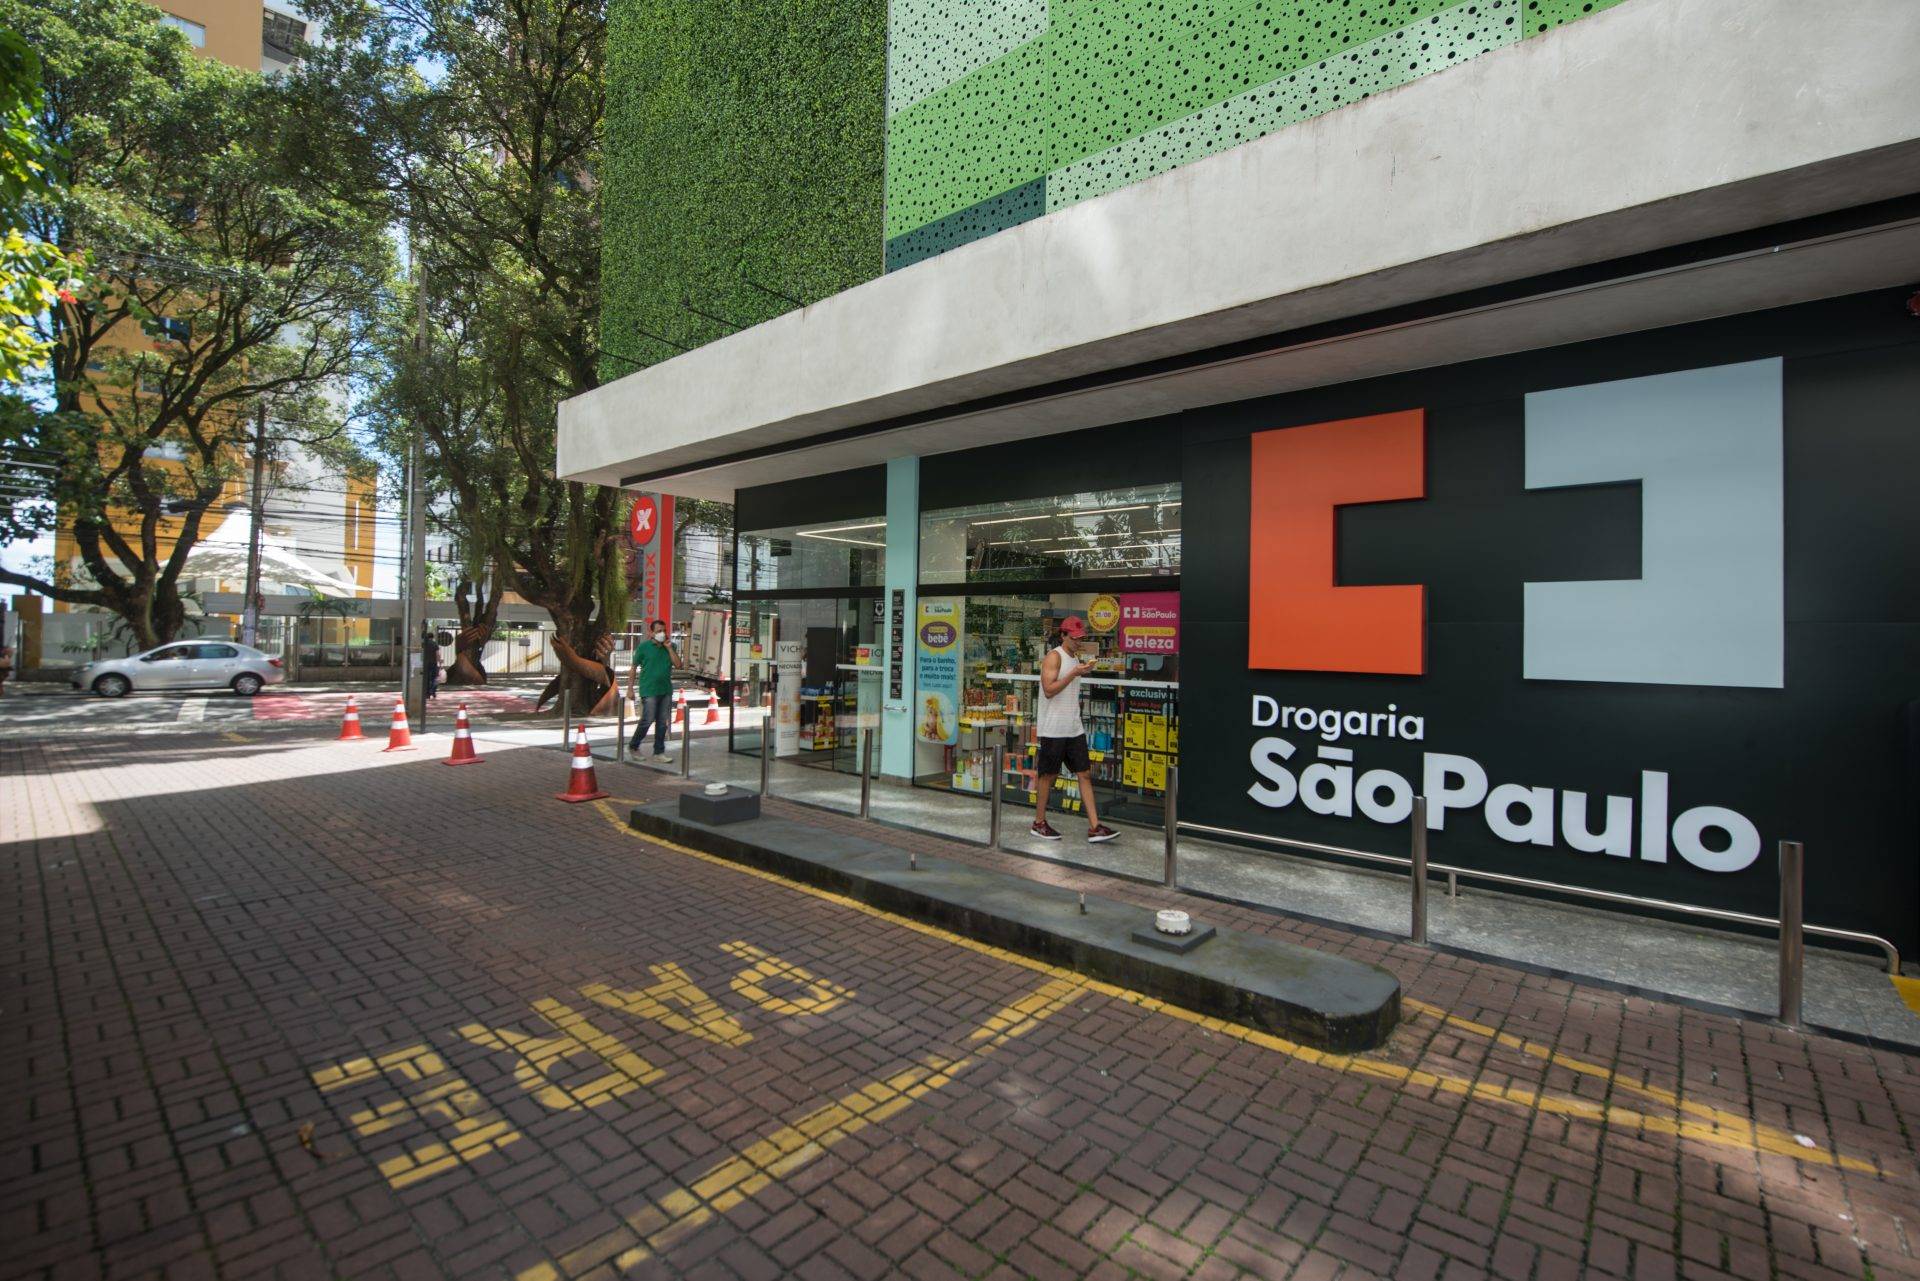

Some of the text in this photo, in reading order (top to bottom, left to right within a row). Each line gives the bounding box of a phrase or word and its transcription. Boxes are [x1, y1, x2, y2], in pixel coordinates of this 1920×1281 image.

[1125, 635, 1174, 649] beleza
[1251, 694, 1425, 741] Drogaria
[311, 940, 857, 1190] PARE
